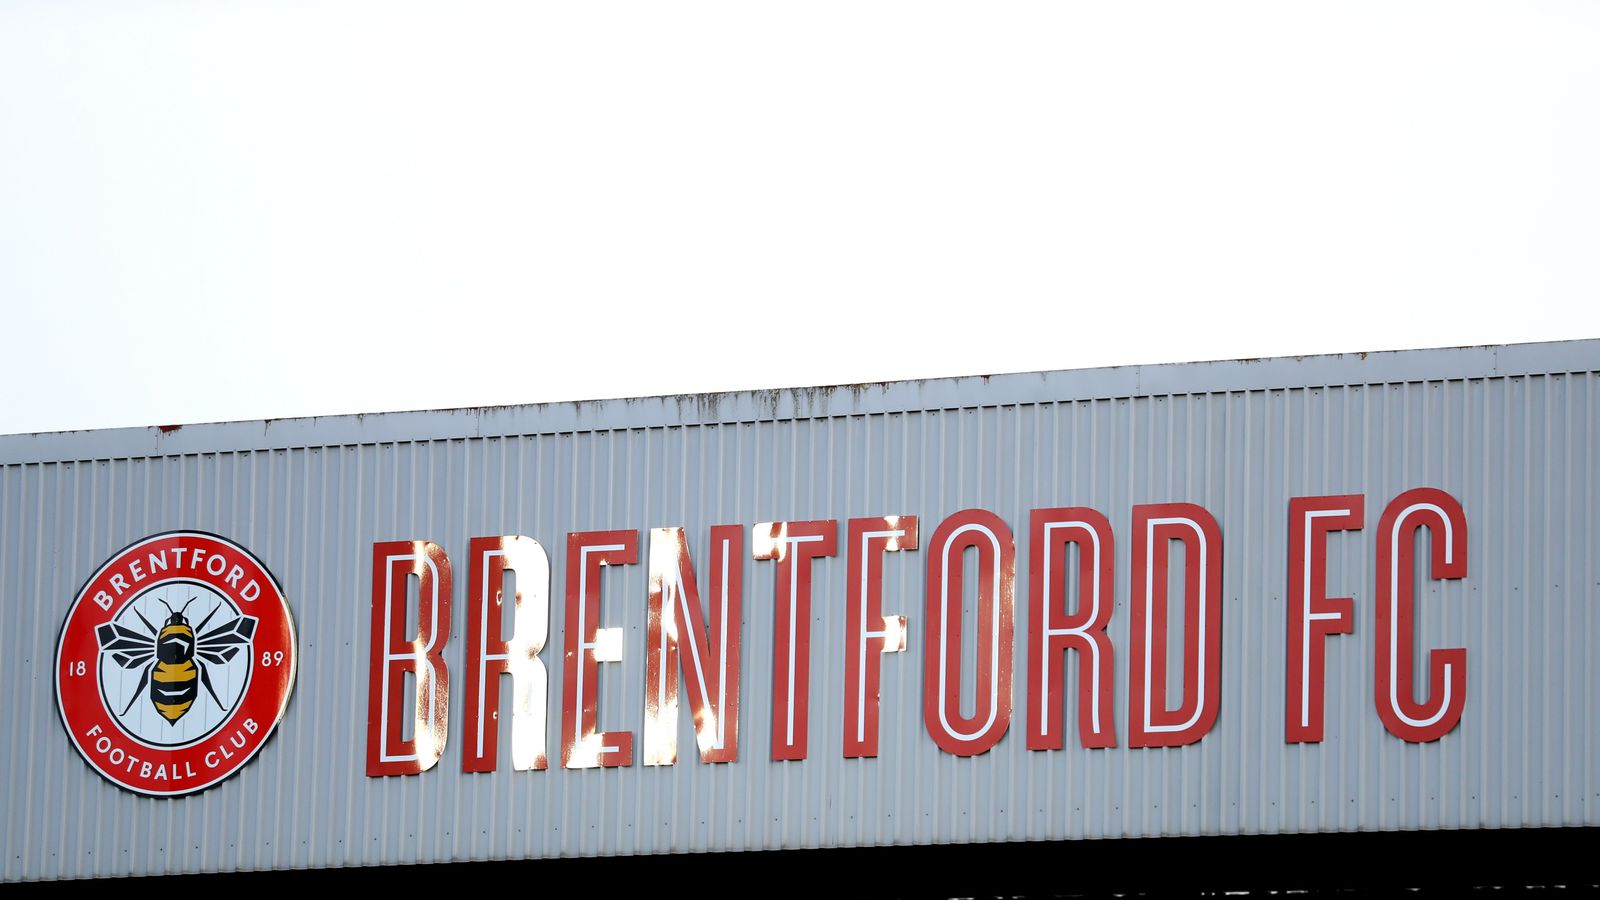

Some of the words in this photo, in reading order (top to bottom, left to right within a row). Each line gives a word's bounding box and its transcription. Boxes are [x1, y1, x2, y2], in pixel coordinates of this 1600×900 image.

[92, 547, 261, 612] BRENTFORD
[261, 651, 284, 667] 89
[366, 502, 1223, 778] BRENTFORD
[1285, 487, 1468, 744] FC
[68, 661, 87, 677] 18
[86, 724, 197, 780] FOOTBALL
[204, 717, 259, 769] CLUB
